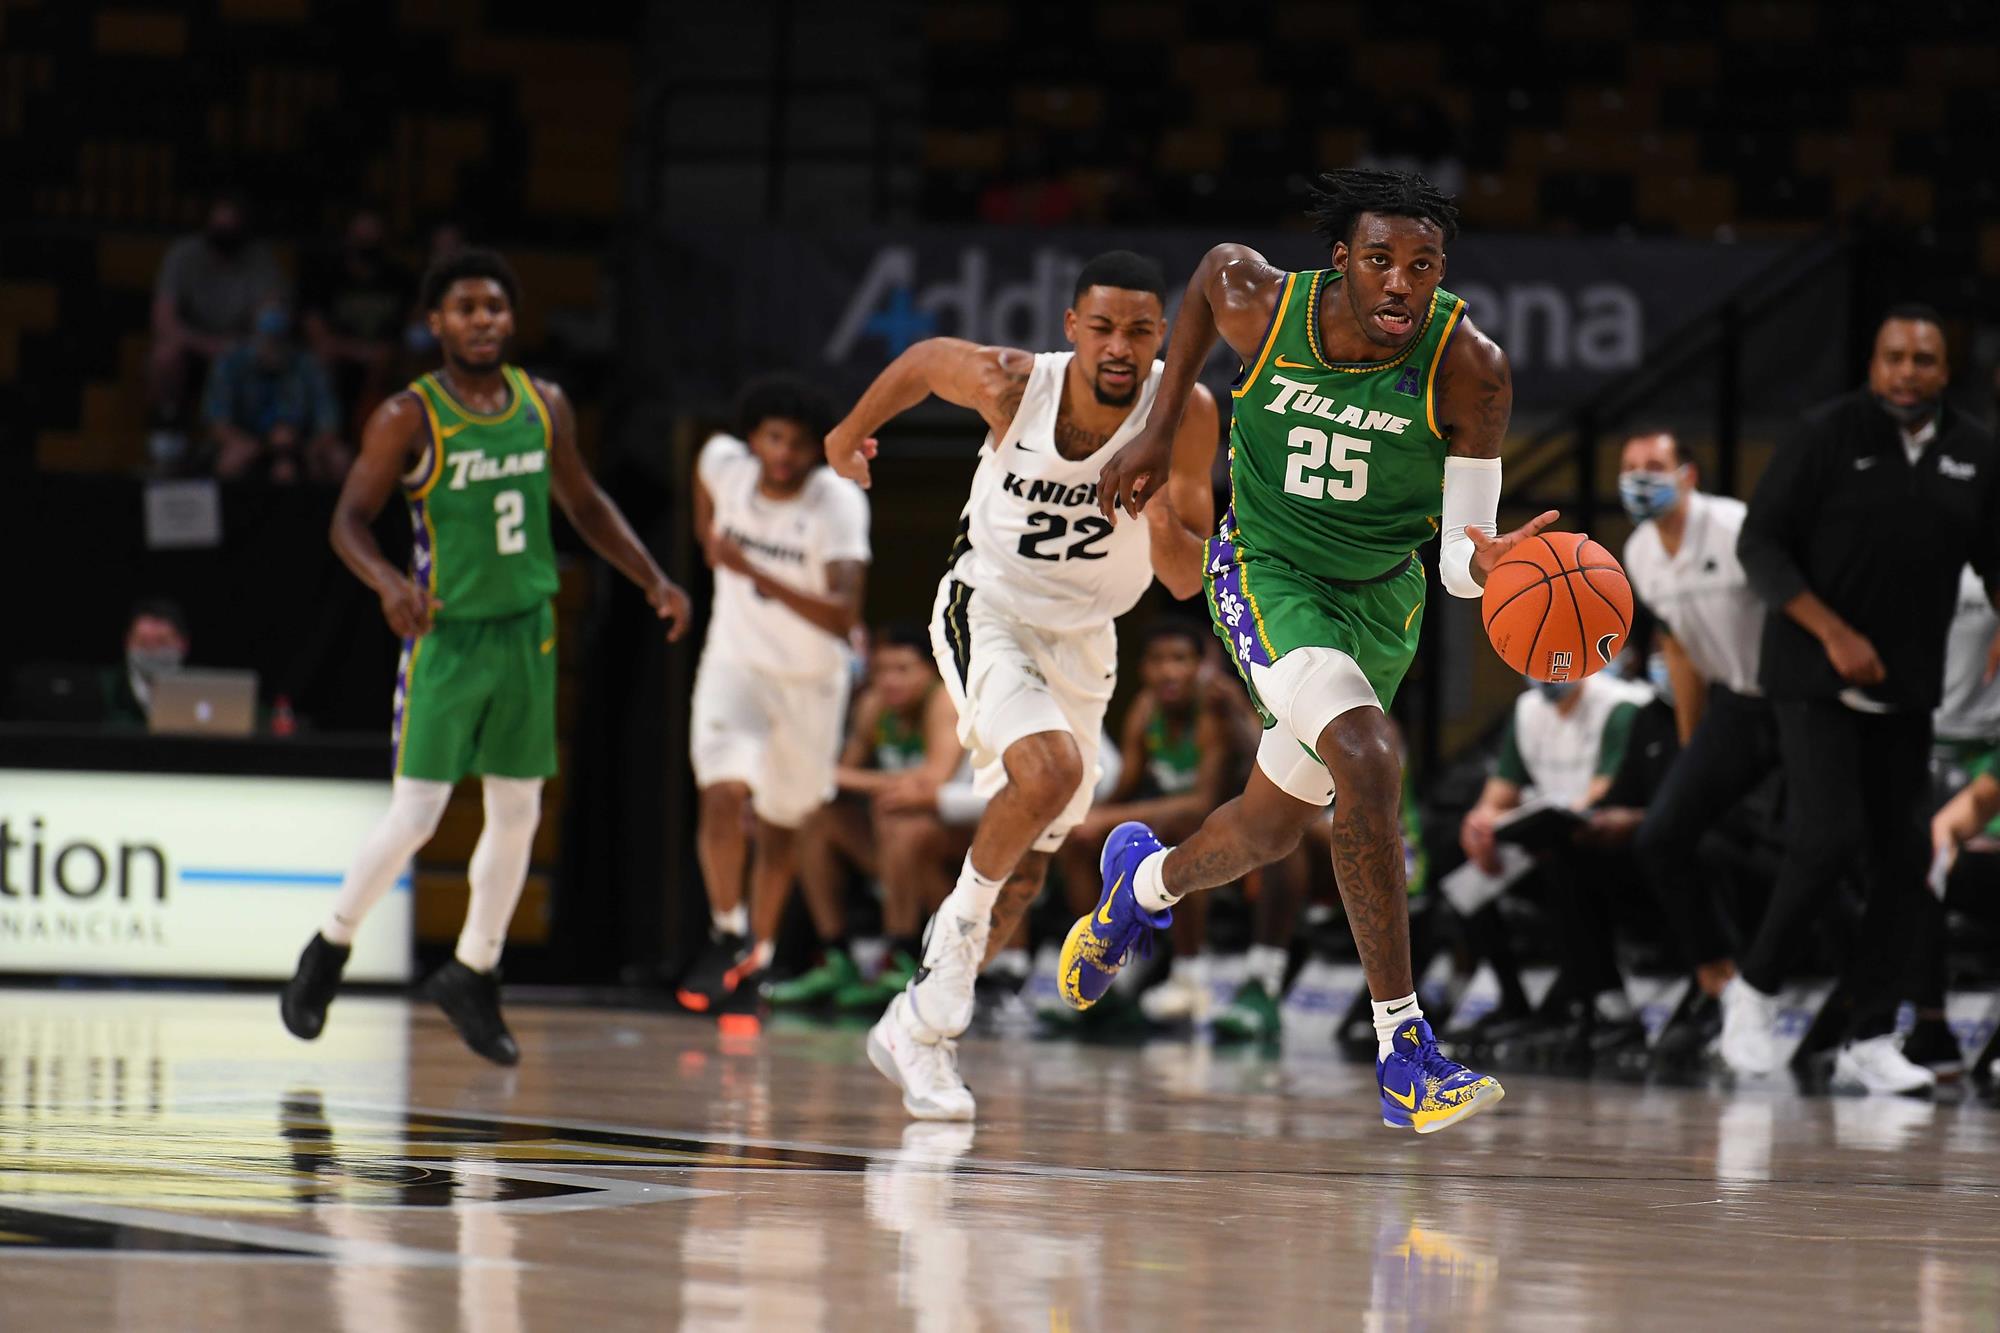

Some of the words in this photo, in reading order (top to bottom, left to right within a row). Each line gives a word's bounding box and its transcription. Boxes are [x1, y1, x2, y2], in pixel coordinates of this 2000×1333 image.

[824, 248, 1082, 362] Addi
[1453, 282, 1642, 370] ena
[1264, 375, 1412, 434] TULANE
[1003, 472, 1122, 508] KNIG
[1284, 426, 1372, 501] 25
[494, 490, 527, 555] 2
[1018, 511, 1114, 561] 22
[0, 819, 166, 901] tion
